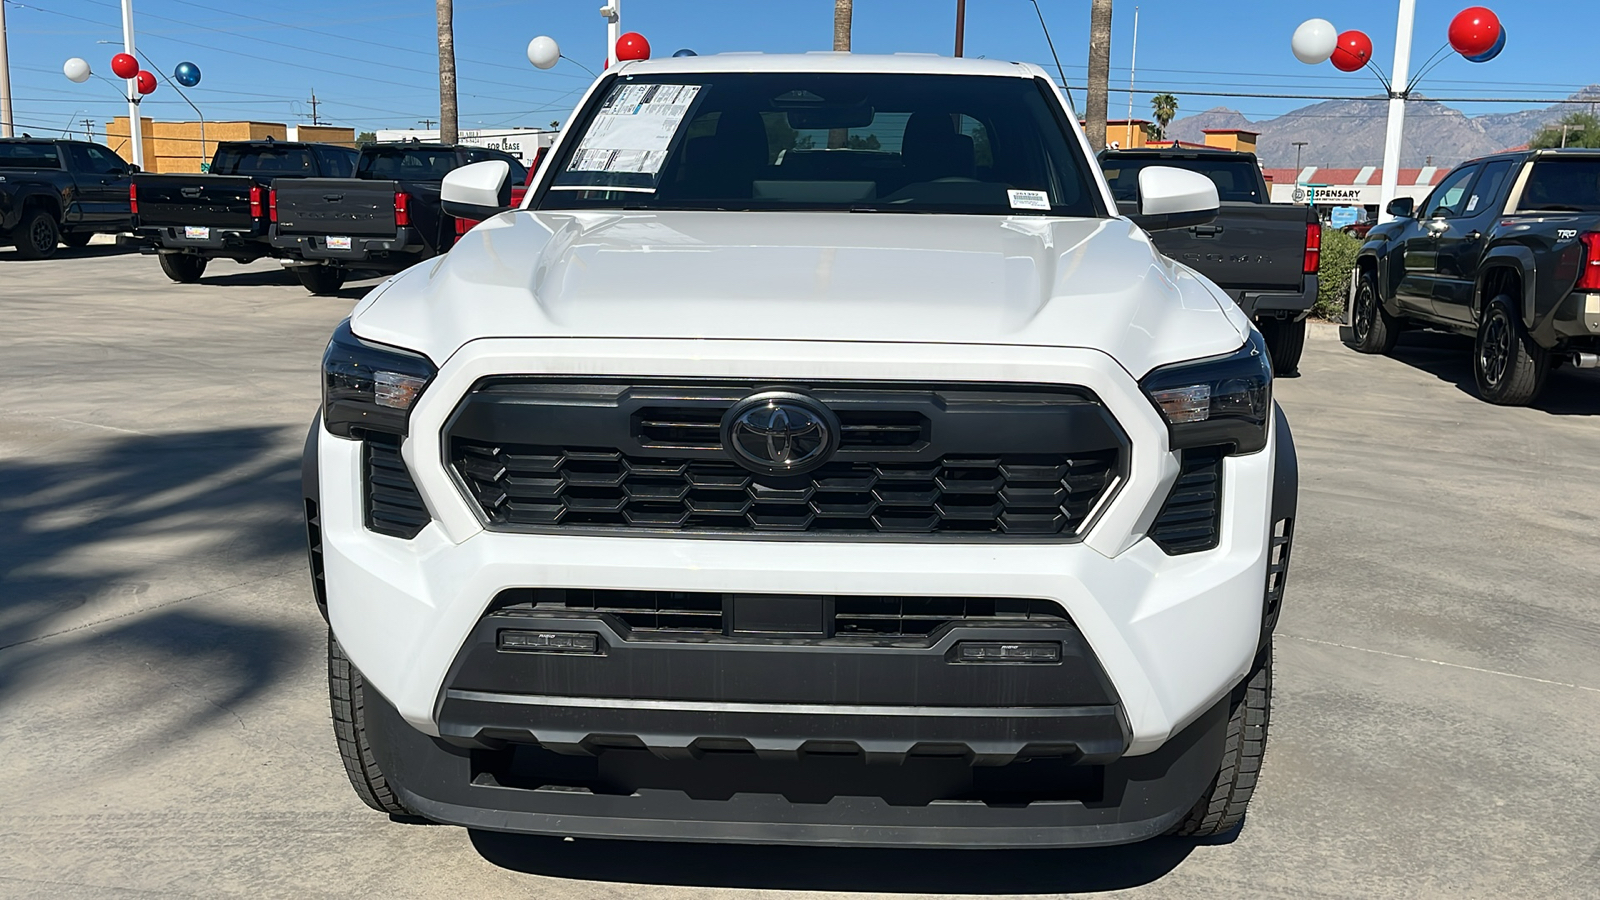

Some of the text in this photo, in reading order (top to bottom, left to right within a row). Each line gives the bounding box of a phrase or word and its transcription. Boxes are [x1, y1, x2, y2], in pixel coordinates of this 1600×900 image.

[501, 143, 520, 151] LEASE
[1306, 189, 1361, 198] DISPENSARY
[1557, 229, 1578, 239] TRD
